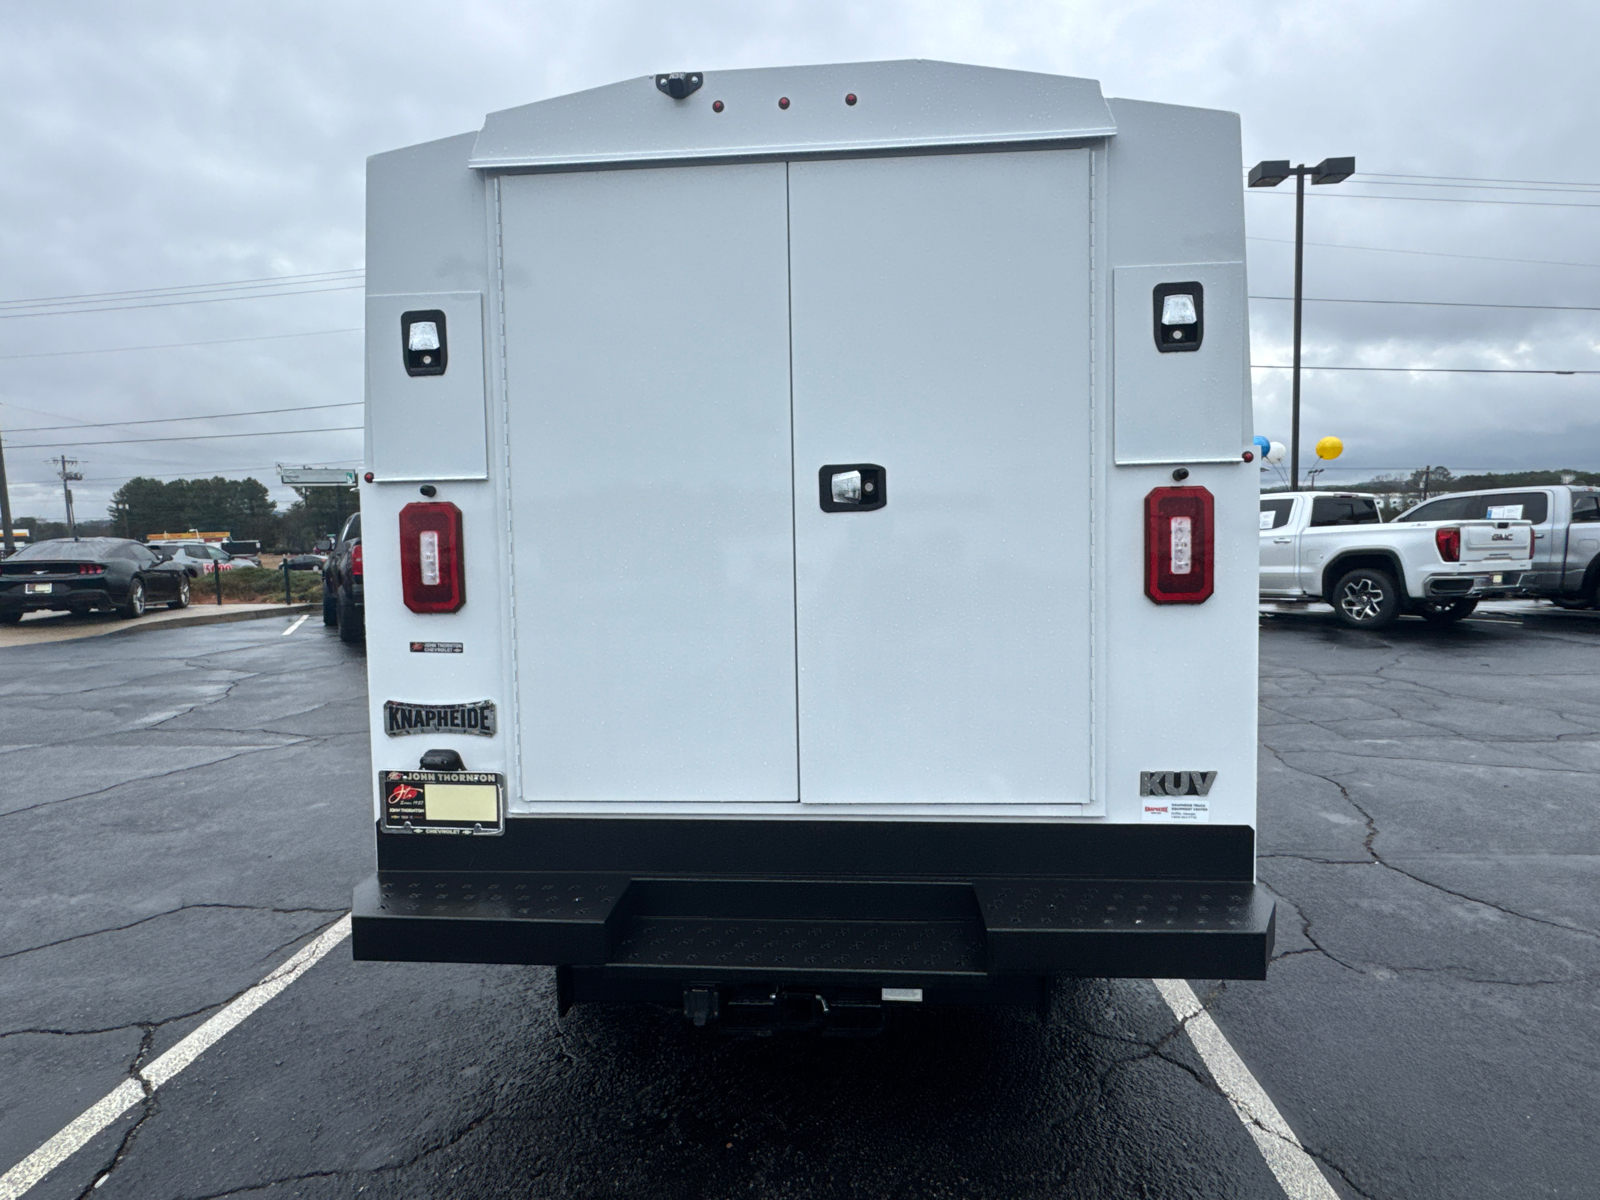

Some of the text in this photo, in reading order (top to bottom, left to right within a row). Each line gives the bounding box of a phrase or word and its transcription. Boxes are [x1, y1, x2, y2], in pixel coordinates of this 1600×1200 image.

[387, 705, 491, 731] KNAPHEIDE
[407, 772, 436, 781] JOHN
[437, 773, 496, 782] THORNTON
[1140, 771, 1218, 797] KUV
